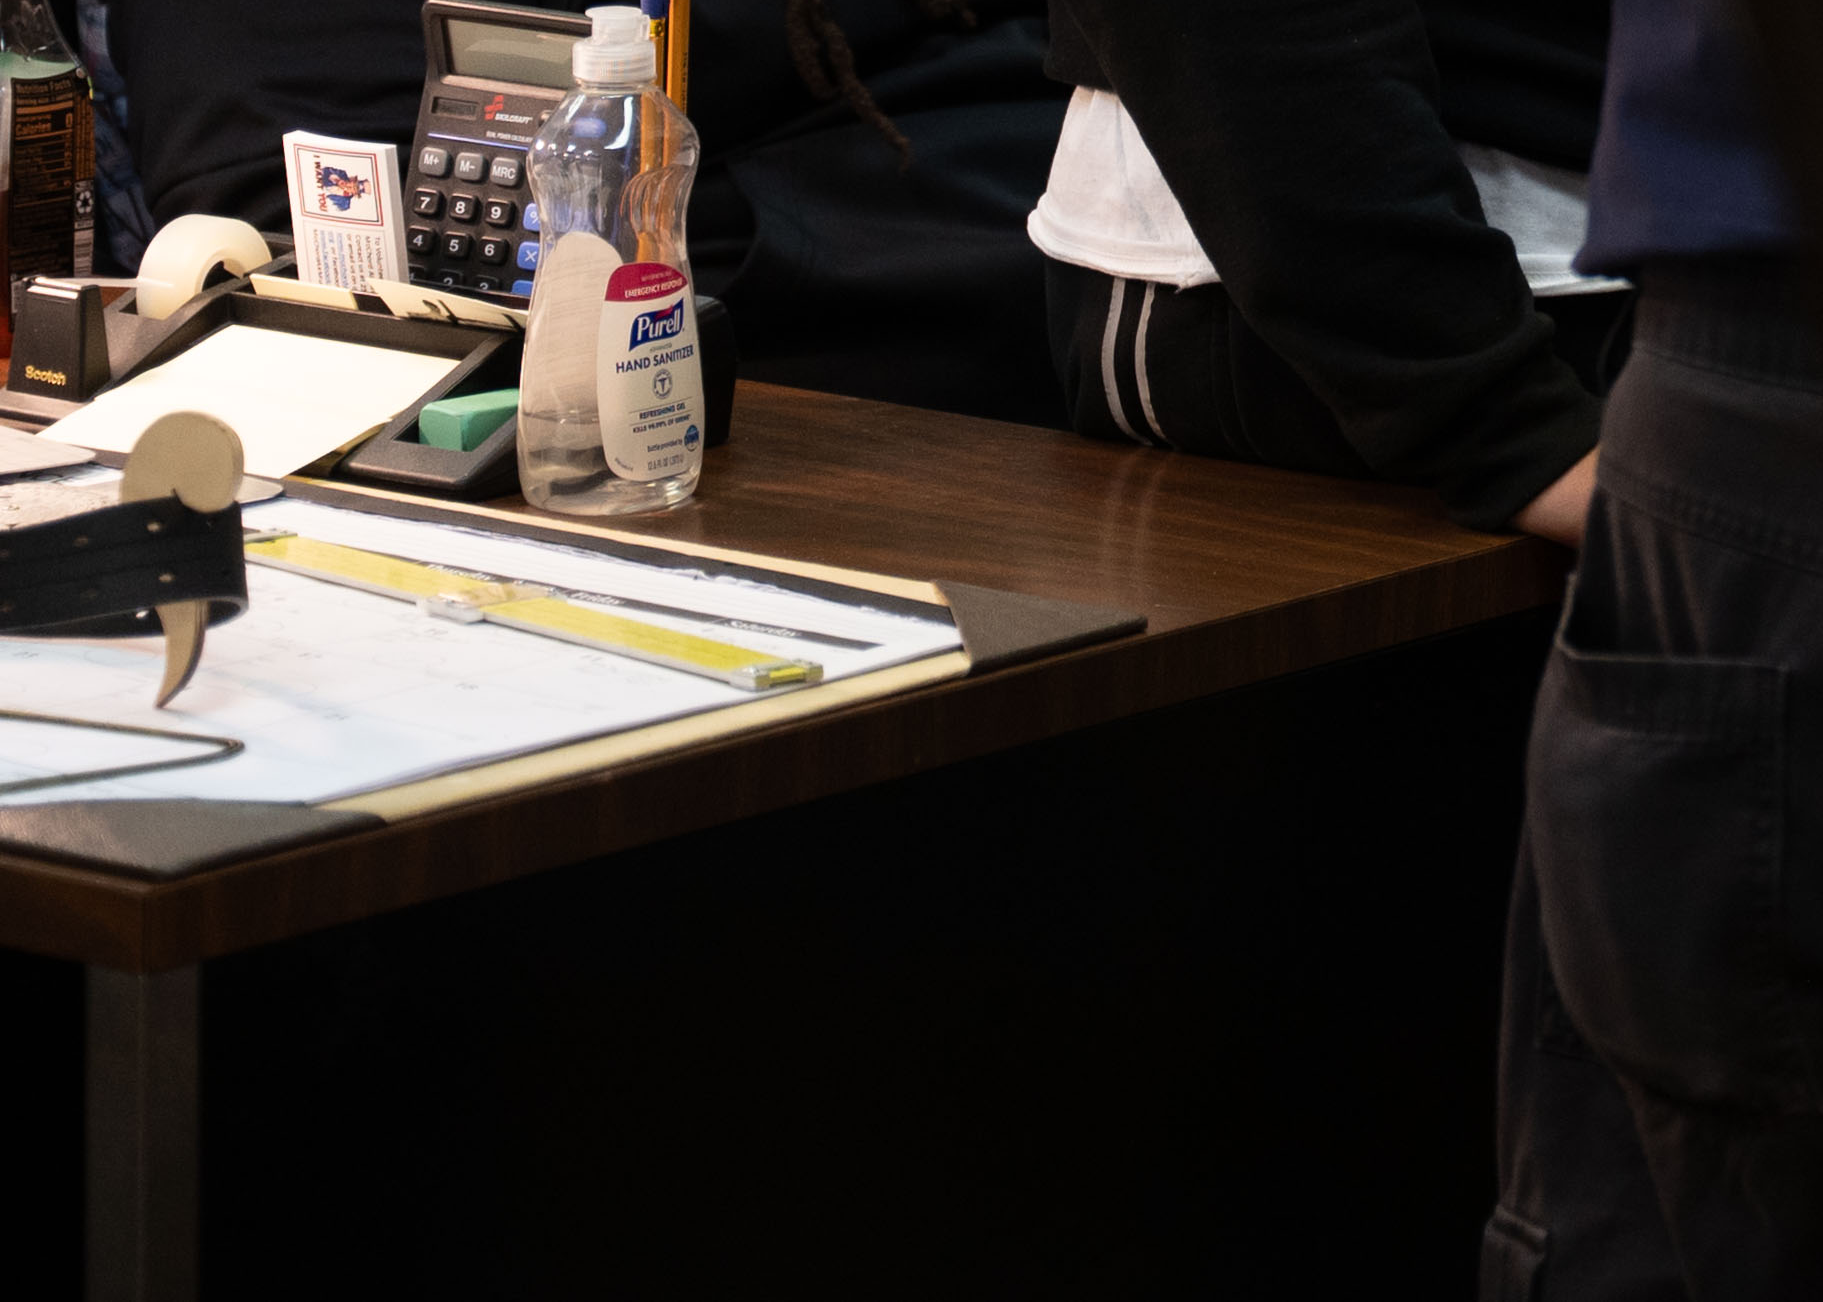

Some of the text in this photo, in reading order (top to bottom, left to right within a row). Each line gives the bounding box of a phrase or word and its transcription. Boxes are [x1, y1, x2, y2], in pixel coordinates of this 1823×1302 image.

[314, 161, 324, 190] WANT
[423, 154, 440, 166] M+
[492, 165, 516, 180] MRC
[317, 193, 328, 212] YOU
[419, 197, 431, 210] 7
[455, 201, 466, 215] 8
[491, 206, 502, 219] 9
[413, 234, 424, 247] 4
[449, 239, 459, 252] 5
[484, 243, 495, 257] 6
[624, 283, 660, 298] EMERGENCY
[636, 308, 681, 341] Purell
[615, 344, 694, 373] HAND SANITIZER
[25, 365, 66, 386] Scotch
[568, 590, 625, 606] Friday
[729, 619, 800, 639] Saturday
